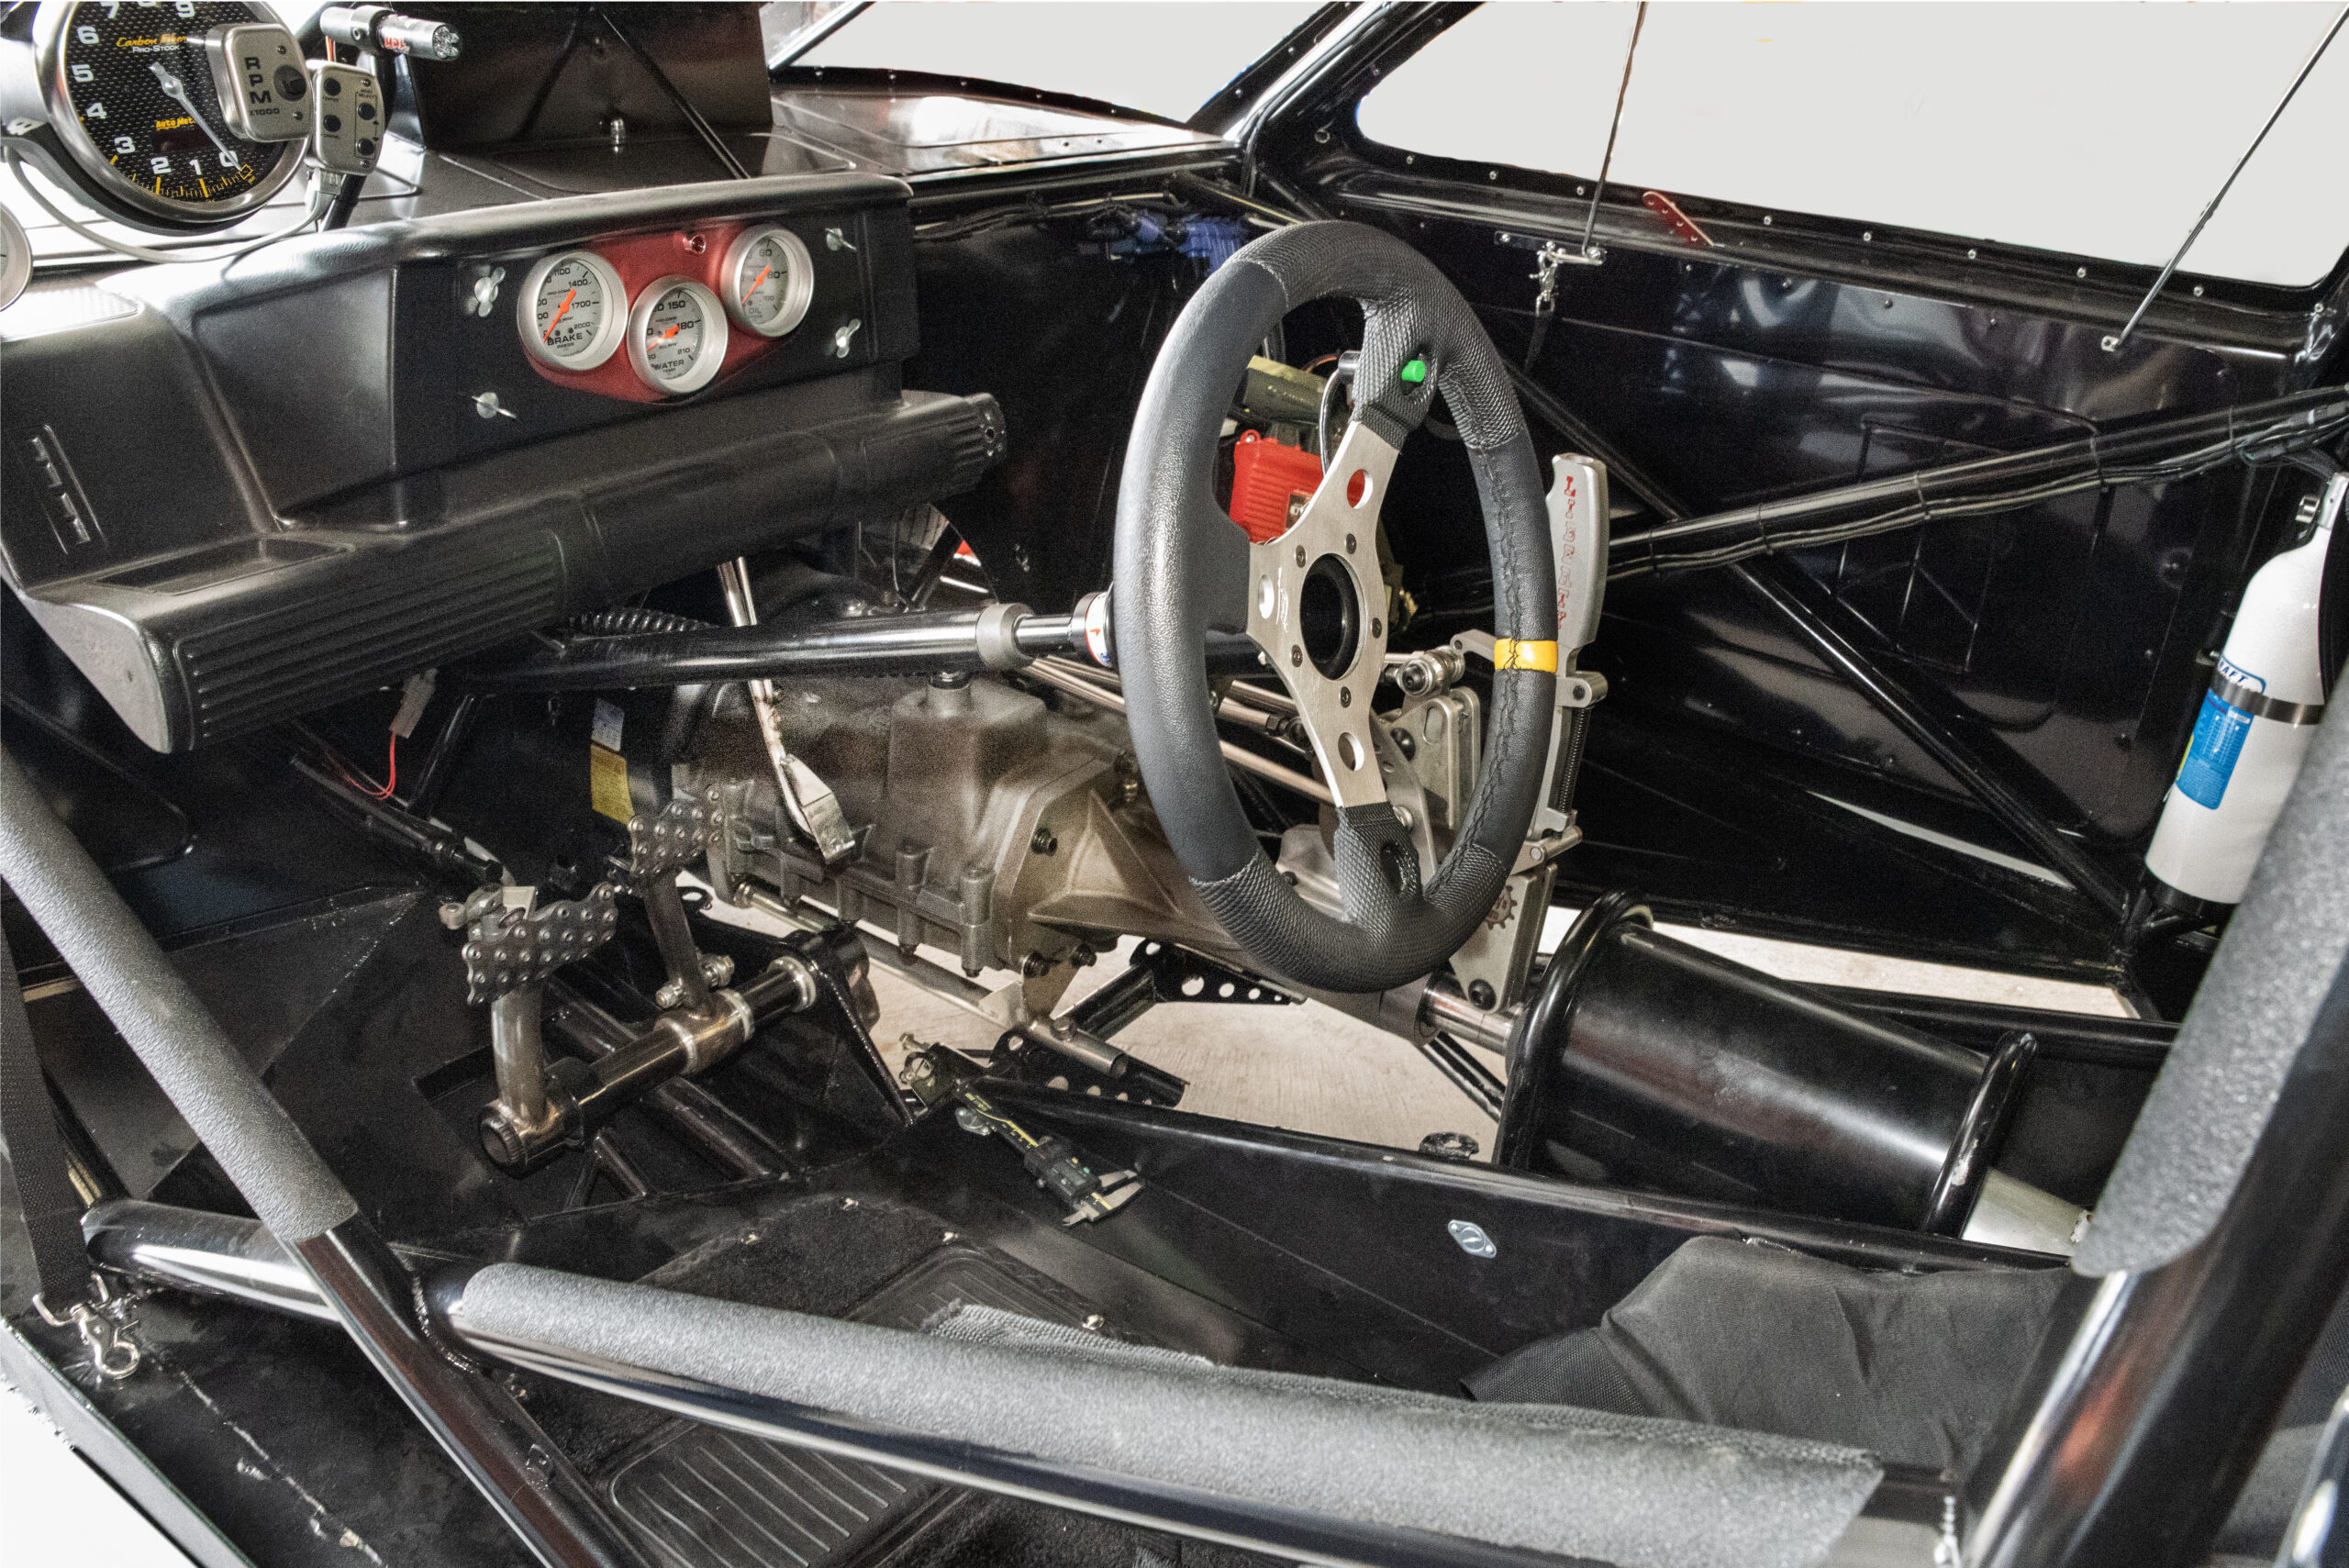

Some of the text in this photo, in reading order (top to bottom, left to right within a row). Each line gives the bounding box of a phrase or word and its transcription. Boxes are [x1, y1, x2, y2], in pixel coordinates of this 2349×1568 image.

[77, 26, 99, 44] 6
[116, 36, 158, 47] Carbon
[72, 63, 94, 83] 5
[85, 102, 107, 119] 4
[155, 117, 196, 130] Auto Met
[114, 137, 136, 153] 3
[150, 157, 172, 174] 2
[189, 159, 202, 175] 1
[568, 279, 588, 288] 1400
[572, 300, 591, 309] 1700
[667, 300, 685, 310] 150
[547, 332, 583, 346] BRAKE
[651, 360, 684, 371] WATER
